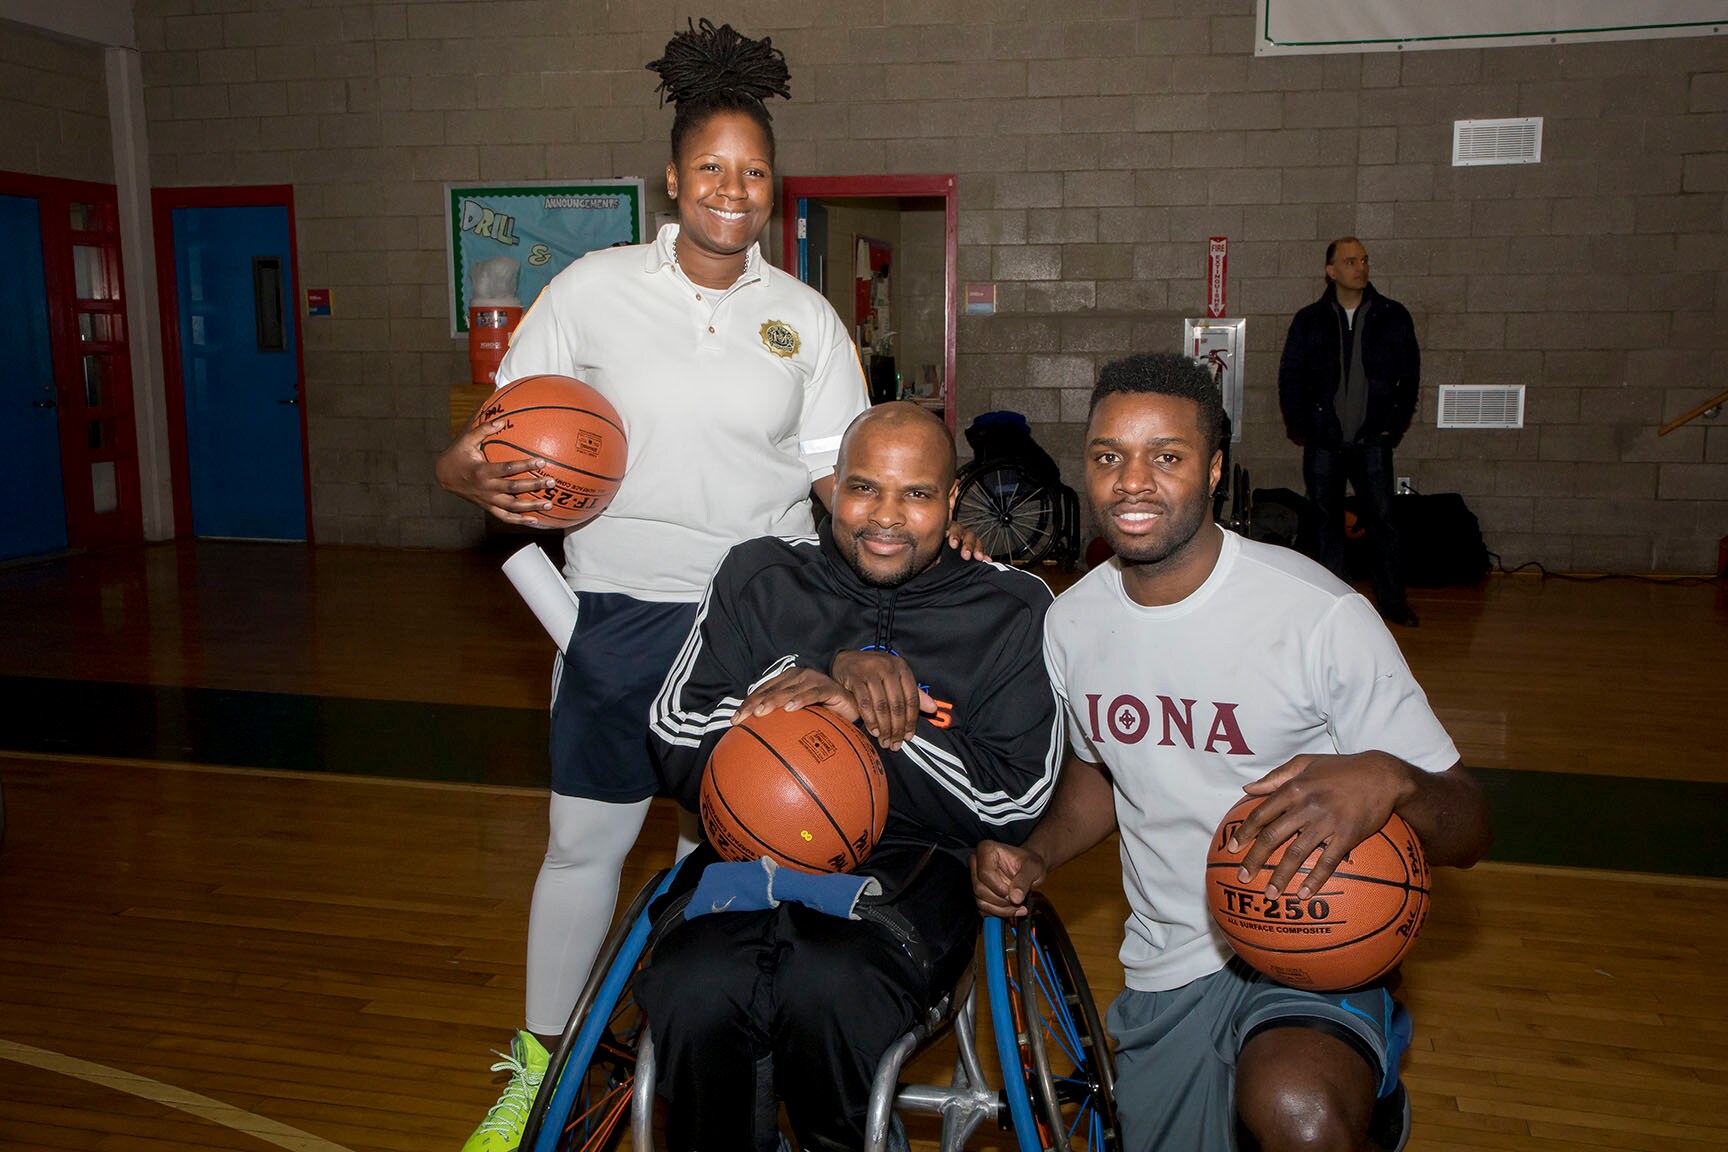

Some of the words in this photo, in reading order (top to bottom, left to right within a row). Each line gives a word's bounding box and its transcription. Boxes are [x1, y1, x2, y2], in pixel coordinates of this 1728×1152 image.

[544, 197, 620, 209] ANNOUNCEMENTS
[462, 200, 520, 246] DRILL
[528, 243, 551, 266] &
[1211, 244, 1225, 252] FIRE
[530, 486, 599, 509] TF-25
[1085, 694, 1256, 756] IONA
[1223, 888, 1330, 920] TF-250
[1228, 917, 1239, 926] ALL
[1240, 921, 1275, 933] SURFACE
[1276, 926, 1332, 935] COMPOSITE
